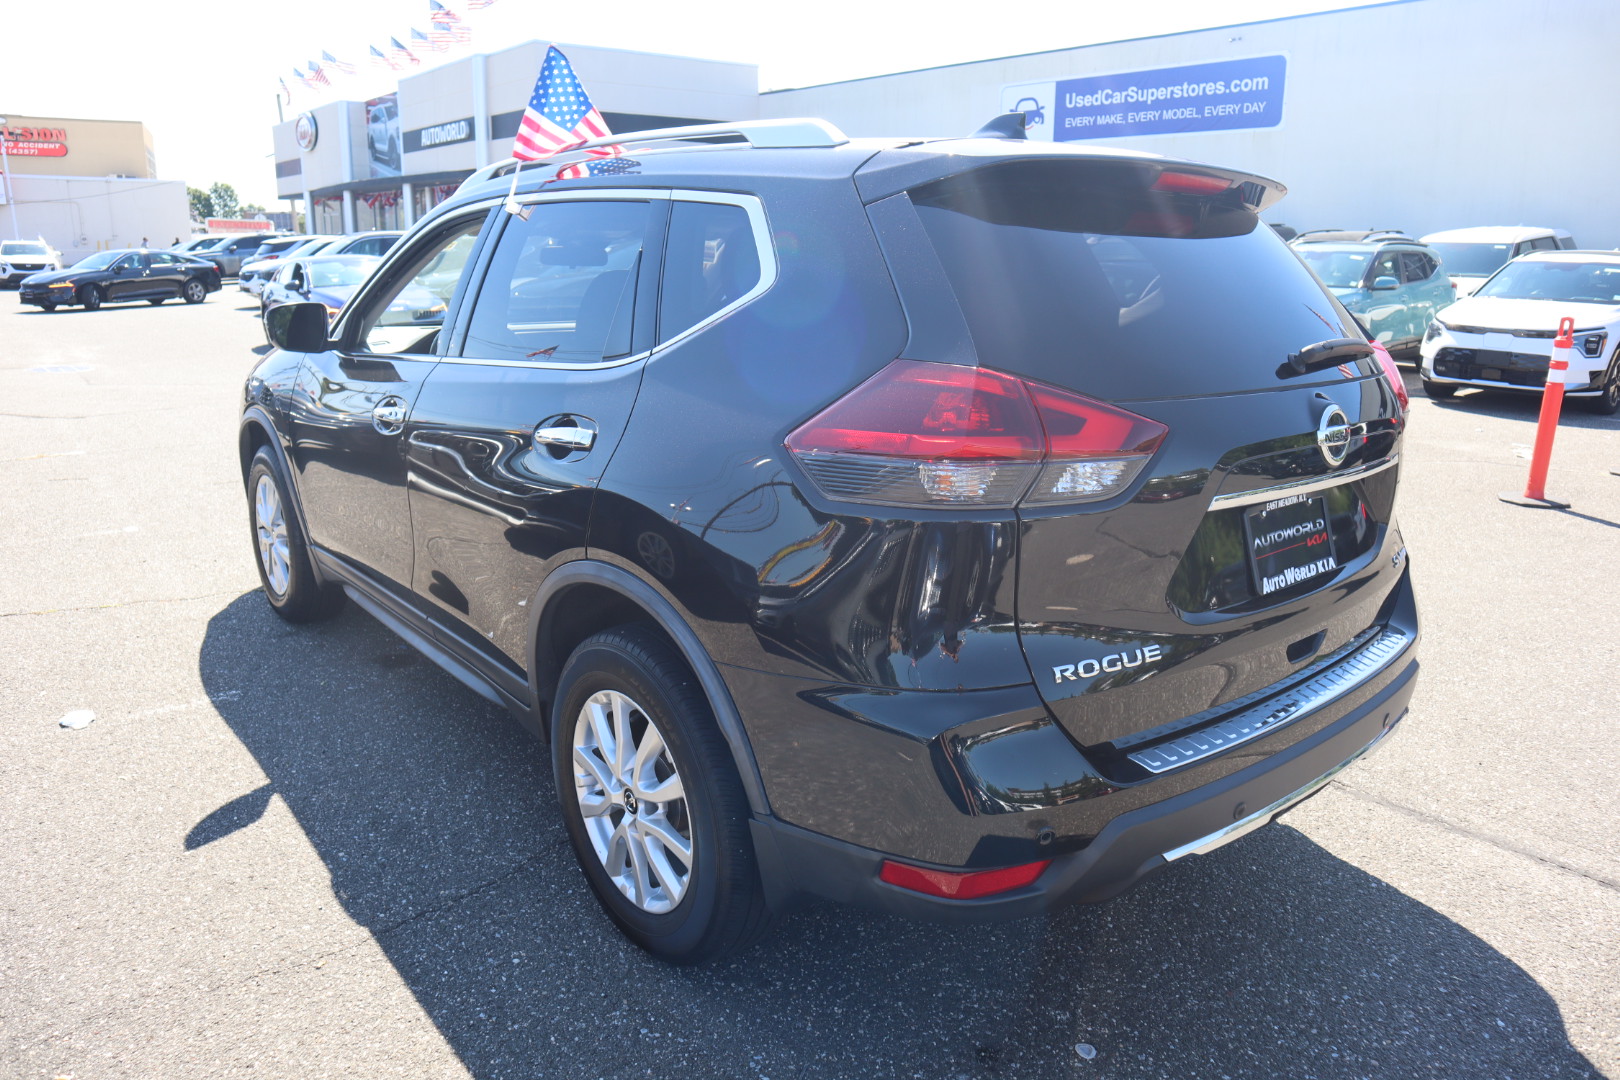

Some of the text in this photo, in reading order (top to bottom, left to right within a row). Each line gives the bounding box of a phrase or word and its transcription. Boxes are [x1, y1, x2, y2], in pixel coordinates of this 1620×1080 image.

[1065, 76, 1269, 108] UsedCarSuperstores.com
[1065, 101, 1267, 128] EVERY MAKE, EVERY MODEL, EVERY DAY
[421, 120, 468, 147] AUTOWORLD
[1266, 500, 1278, 512] EAST
[1254, 518, 1324, 550] AUTOWORLD
[1316, 556, 1337, 574] KIA
[1051, 644, 1163, 684] ROGUE
